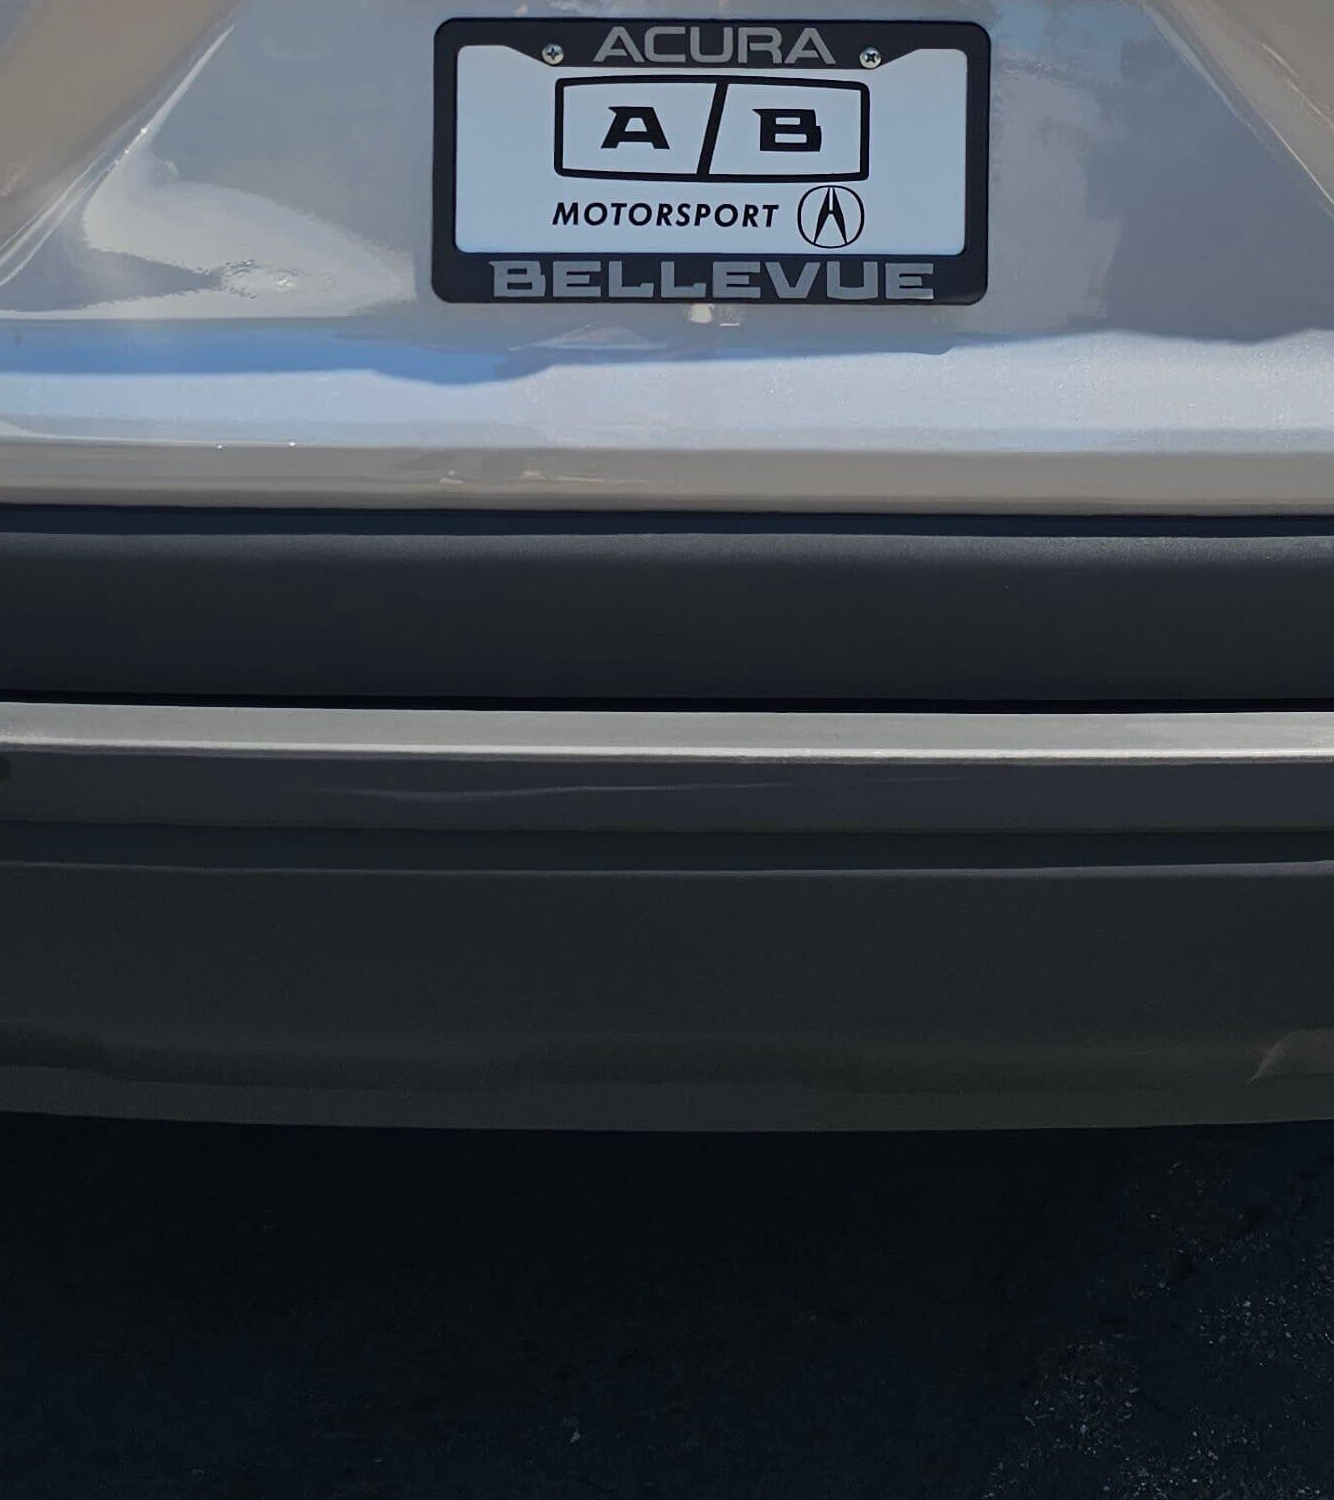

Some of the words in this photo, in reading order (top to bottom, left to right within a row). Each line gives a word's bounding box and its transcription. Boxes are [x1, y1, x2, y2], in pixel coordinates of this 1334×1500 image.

[593, 25, 837, 66] ACURA
[600, 106, 671, 150] A
[752, 108, 823, 153] B
[551, 201, 780, 228] MOTORSPORT
[488, 259, 935, 301] BELLEVUE
